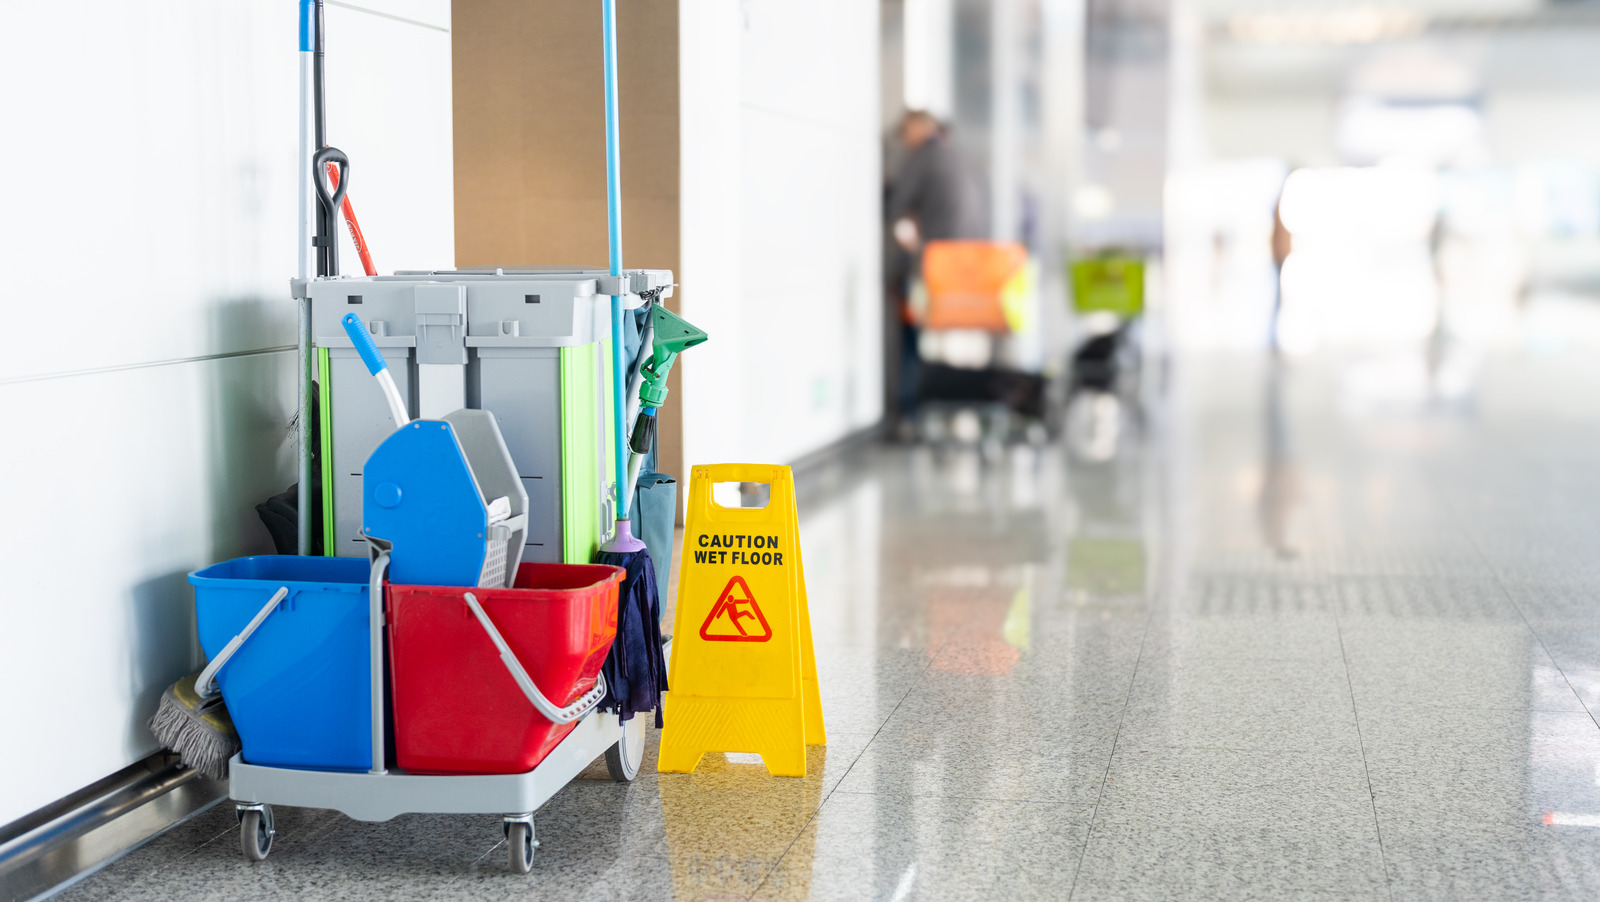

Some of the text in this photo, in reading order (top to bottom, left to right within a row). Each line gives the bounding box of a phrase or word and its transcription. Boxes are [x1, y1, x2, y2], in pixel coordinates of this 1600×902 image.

[698, 534, 779, 549] CAUTION
[694, 550, 783, 566] WET FLOOR
